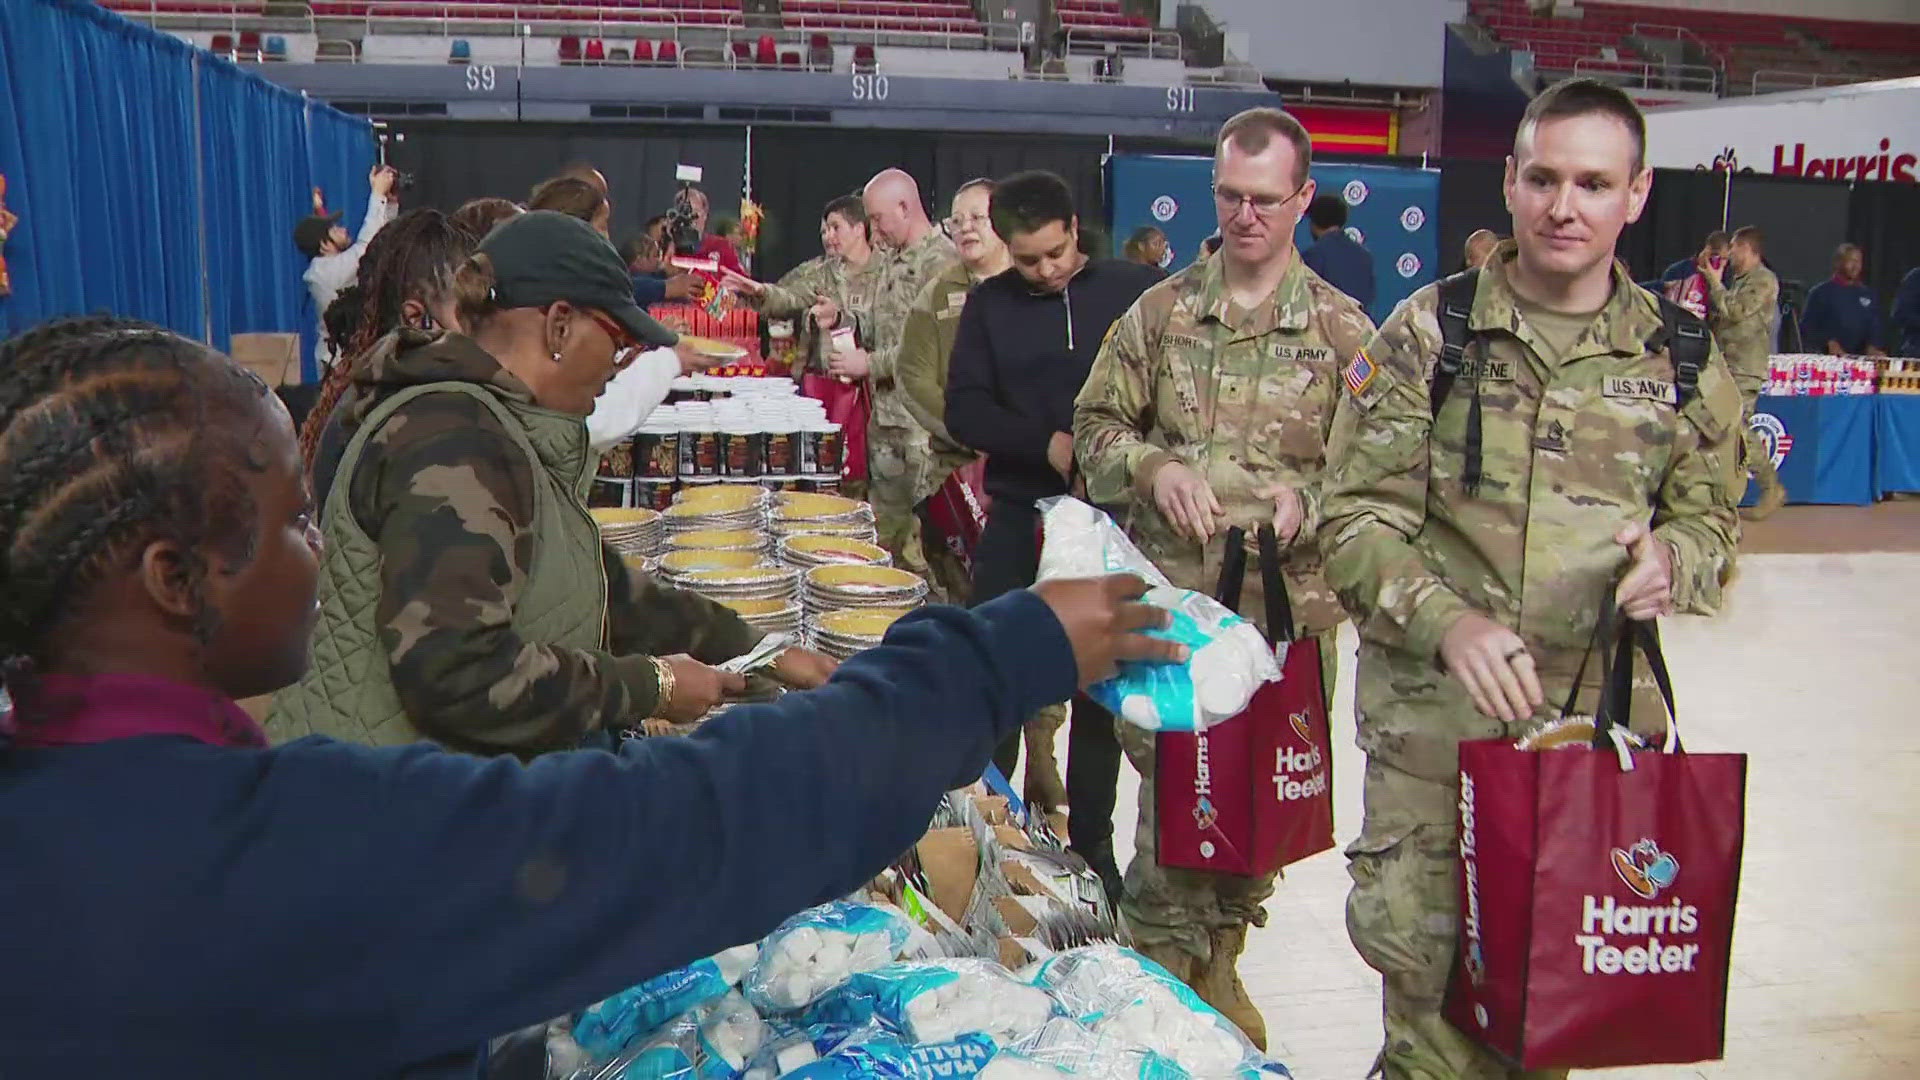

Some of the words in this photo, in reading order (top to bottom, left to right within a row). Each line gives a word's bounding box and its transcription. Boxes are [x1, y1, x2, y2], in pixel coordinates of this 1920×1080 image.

[466, 64, 495, 91] S9
[852, 74, 889, 100] S10
[1167, 86, 1195, 112] S11
[1772, 137, 1917, 183] Harris
[1275, 345, 1294, 360] U.S.
[1295, 348, 1328, 361] ARMY
[1612, 379, 1635, 394] U.S.
[1582, 895, 1698, 935] Harris
[1575, 934, 1699, 975] Teeter
